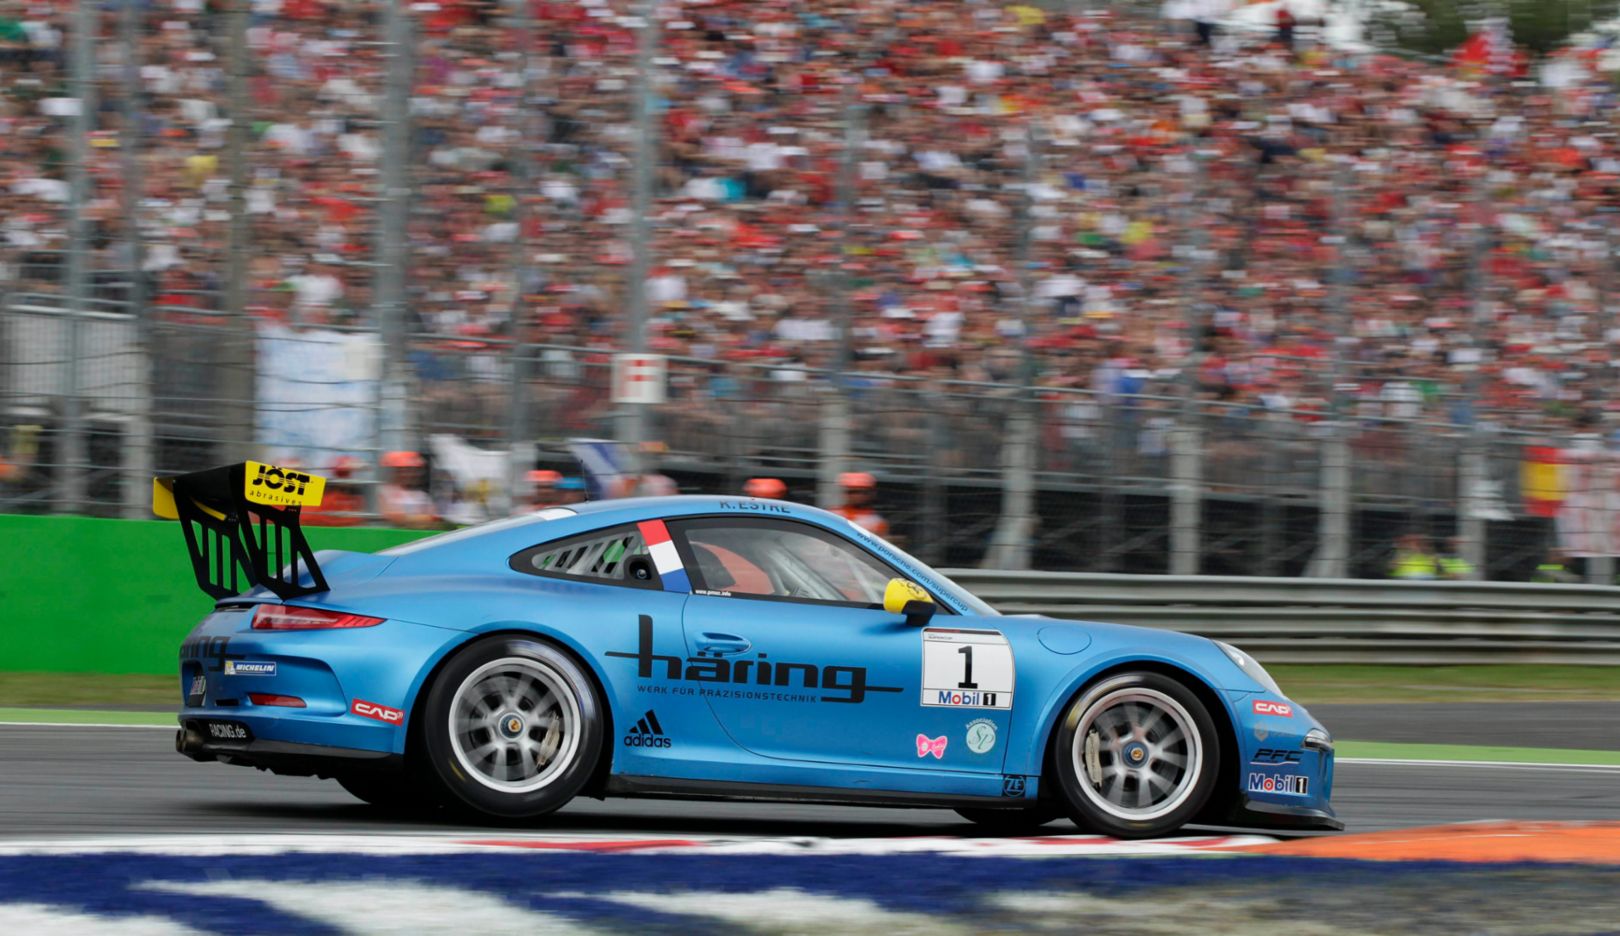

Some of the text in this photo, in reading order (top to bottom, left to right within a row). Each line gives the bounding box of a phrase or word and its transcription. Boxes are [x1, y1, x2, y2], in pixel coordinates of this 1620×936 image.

[252, 464, 310, 496] JÖST
[249, 490, 302, 505] abrasives
[605, 614, 904, 704] häring
[957, 645, 978, 689] 1
[235, 663, 275, 672] MICHELIN
[637, 684, 817, 704] WERK FÜR PRÄZISIONSTECHNIK
[938, 691, 997, 706] Mobil 1
[208, 723, 248, 739] RACING.de
[623, 733, 672, 749] adidas
[1254, 748, 1304, 762] PFC
[1005, 777, 1024, 792] ZF
[1249, 773, 1308, 794] Mobil 1
